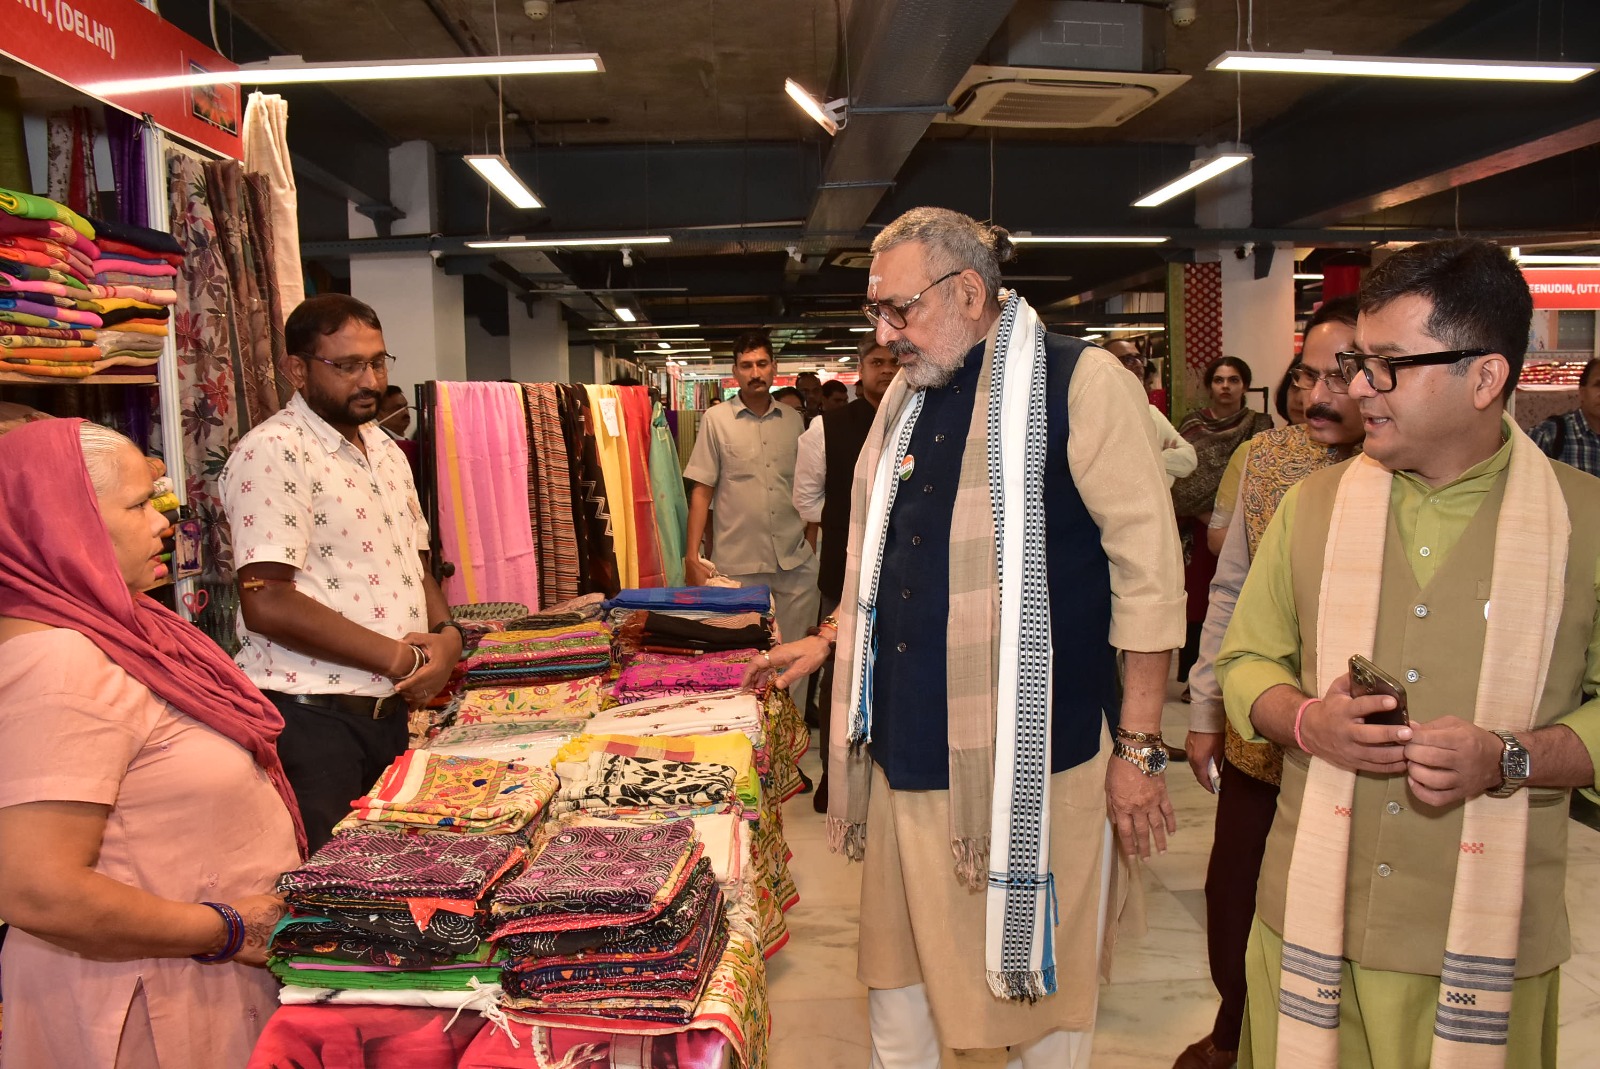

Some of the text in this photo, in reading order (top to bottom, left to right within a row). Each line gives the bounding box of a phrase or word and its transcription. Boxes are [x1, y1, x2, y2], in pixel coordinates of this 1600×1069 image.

[55, 0, 116, 60] (DELHI)
[1529, 283, 1600, 295] EENUDIN, (UTT
